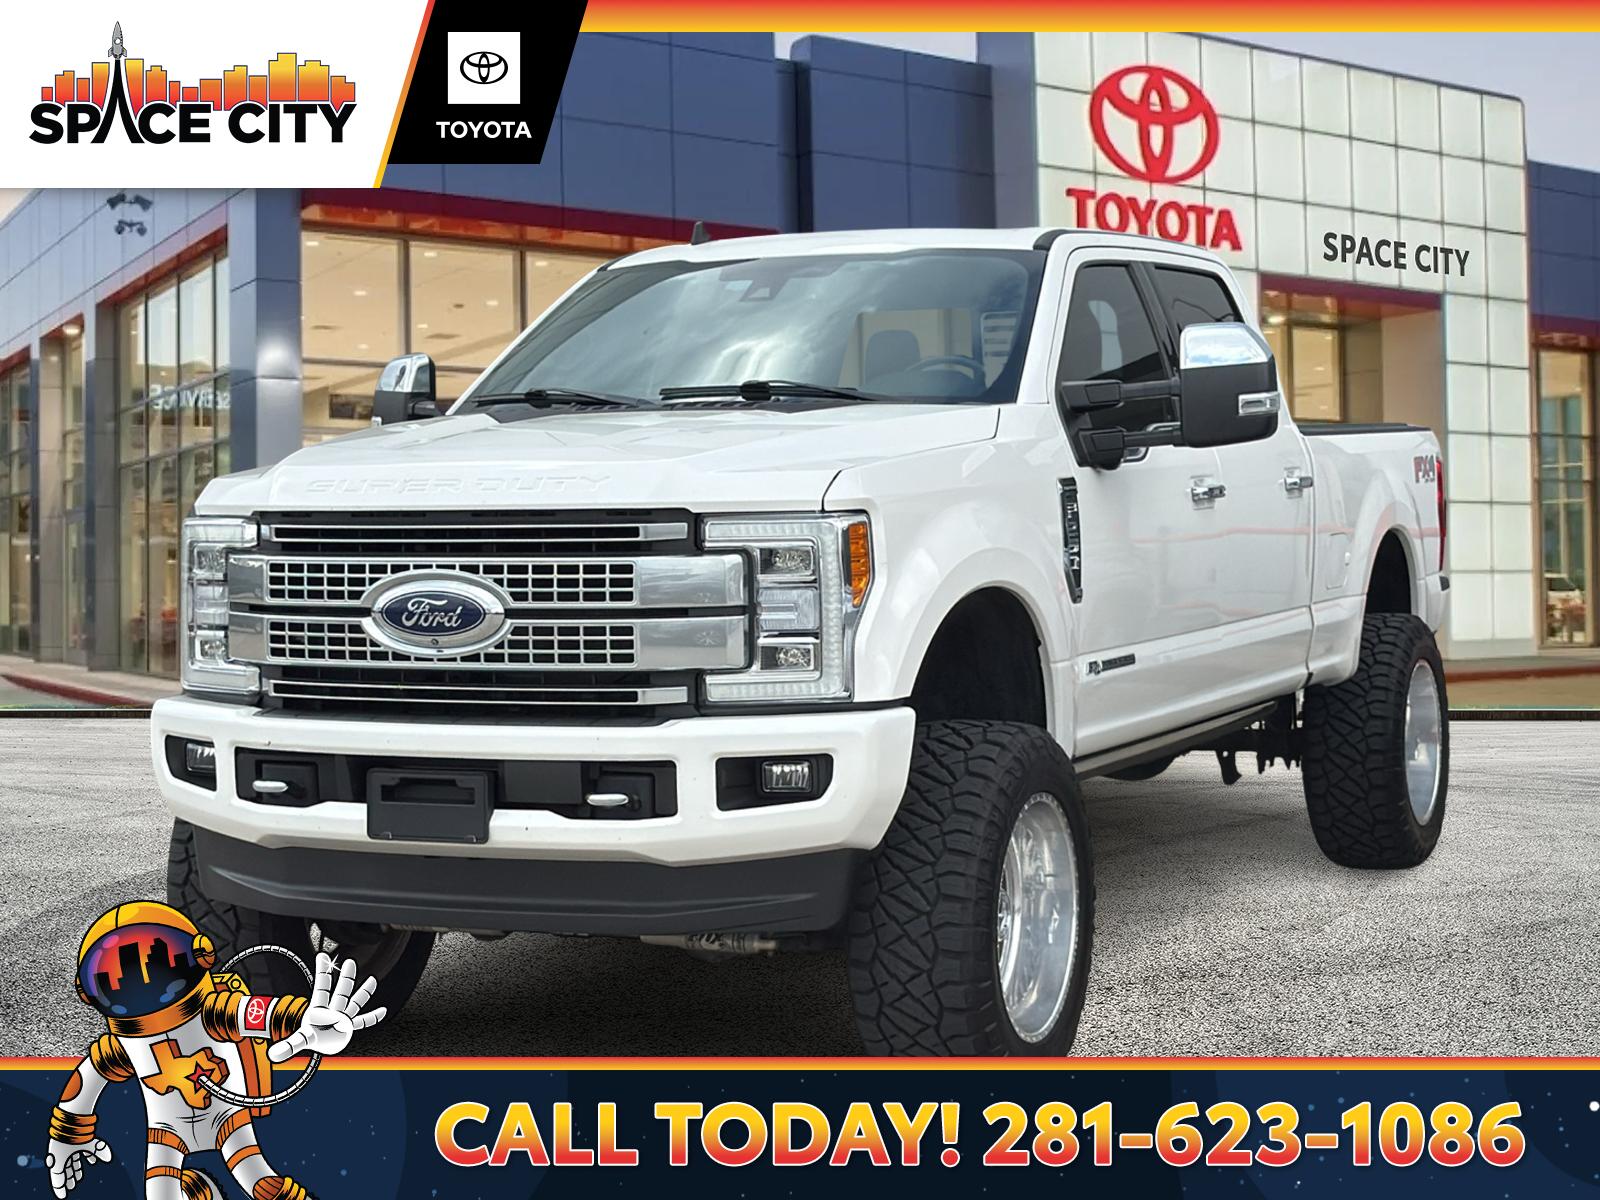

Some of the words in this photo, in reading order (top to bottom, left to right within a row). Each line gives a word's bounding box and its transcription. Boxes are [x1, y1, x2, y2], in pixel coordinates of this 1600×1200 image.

[1065, 187, 1242, 251] TOYOTA
[1323, 231, 1407, 270] SPACE
[1414, 244, 1470, 277] CITY
[305, 477, 465, 495] SUPER
[474, 474, 612, 493] DUTY
[401, 597, 463, 628] Ford
